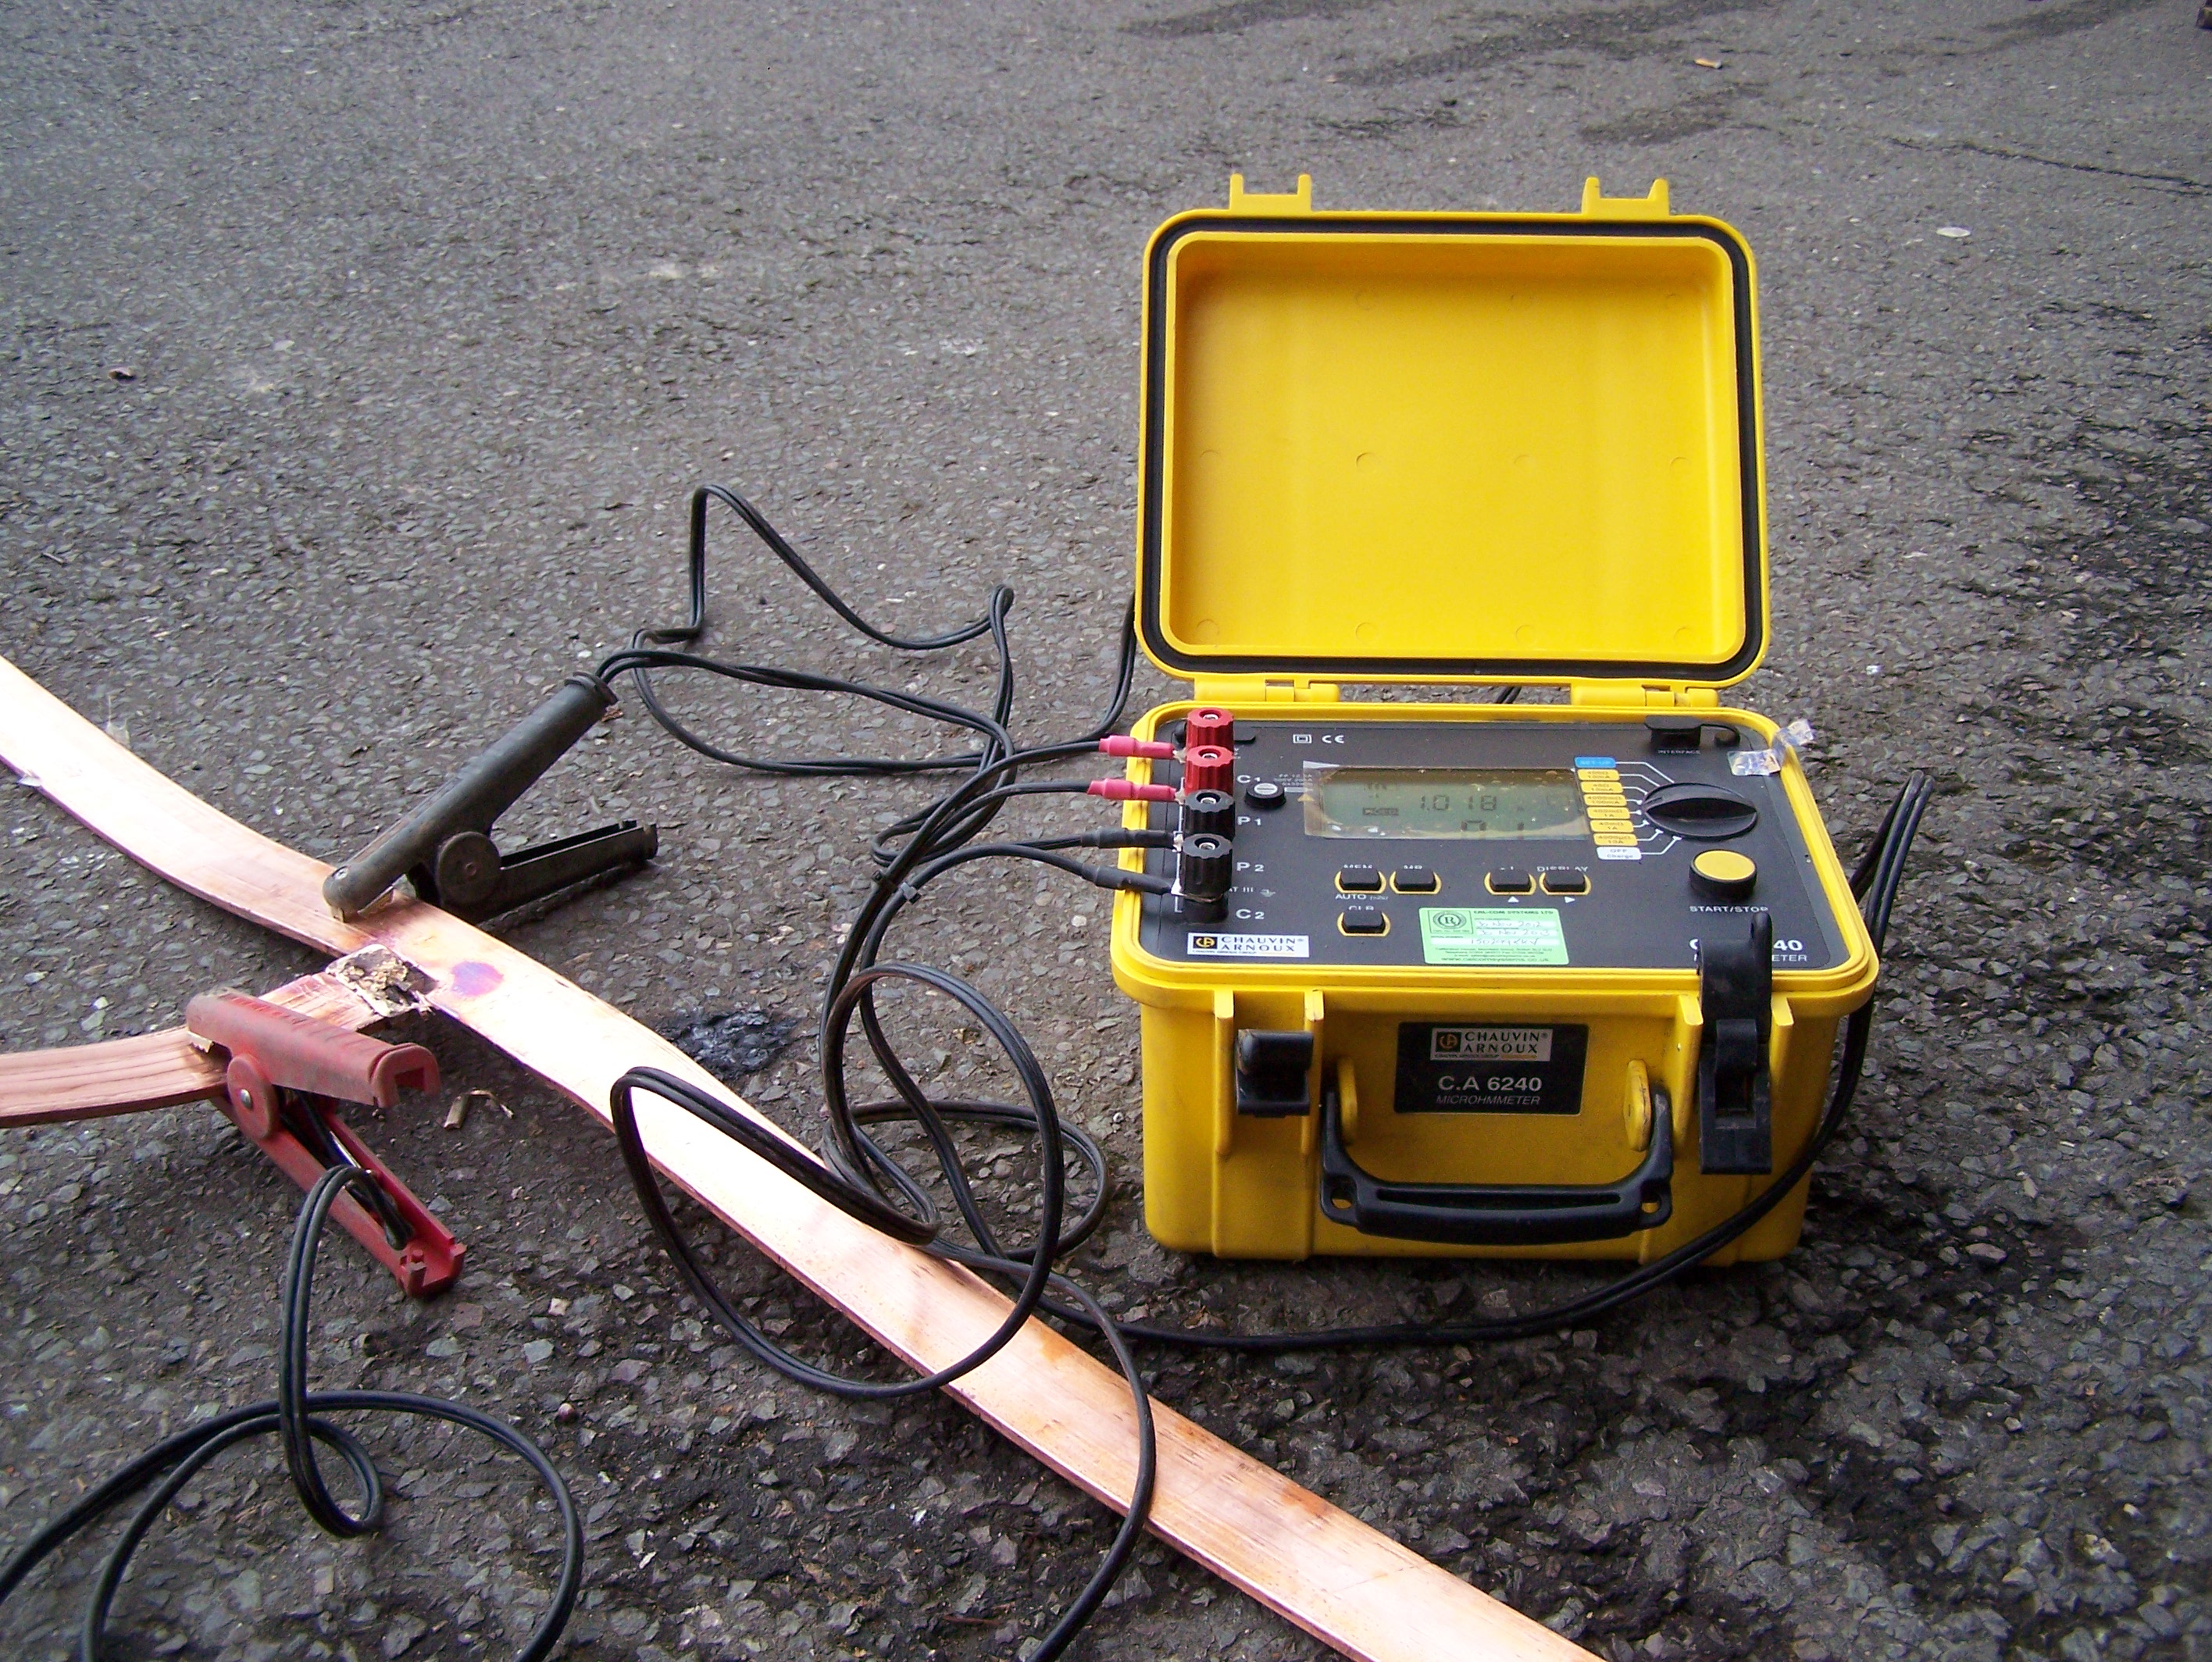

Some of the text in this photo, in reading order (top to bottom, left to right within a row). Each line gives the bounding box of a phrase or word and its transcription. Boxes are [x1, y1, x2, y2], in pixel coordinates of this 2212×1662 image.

[1464, 1043, 1538, 1054] ARNOUX
[1438, 1075, 1543, 1092] C.A 6240
[1436, 1094, 1541, 1106] MICROHMMETER
